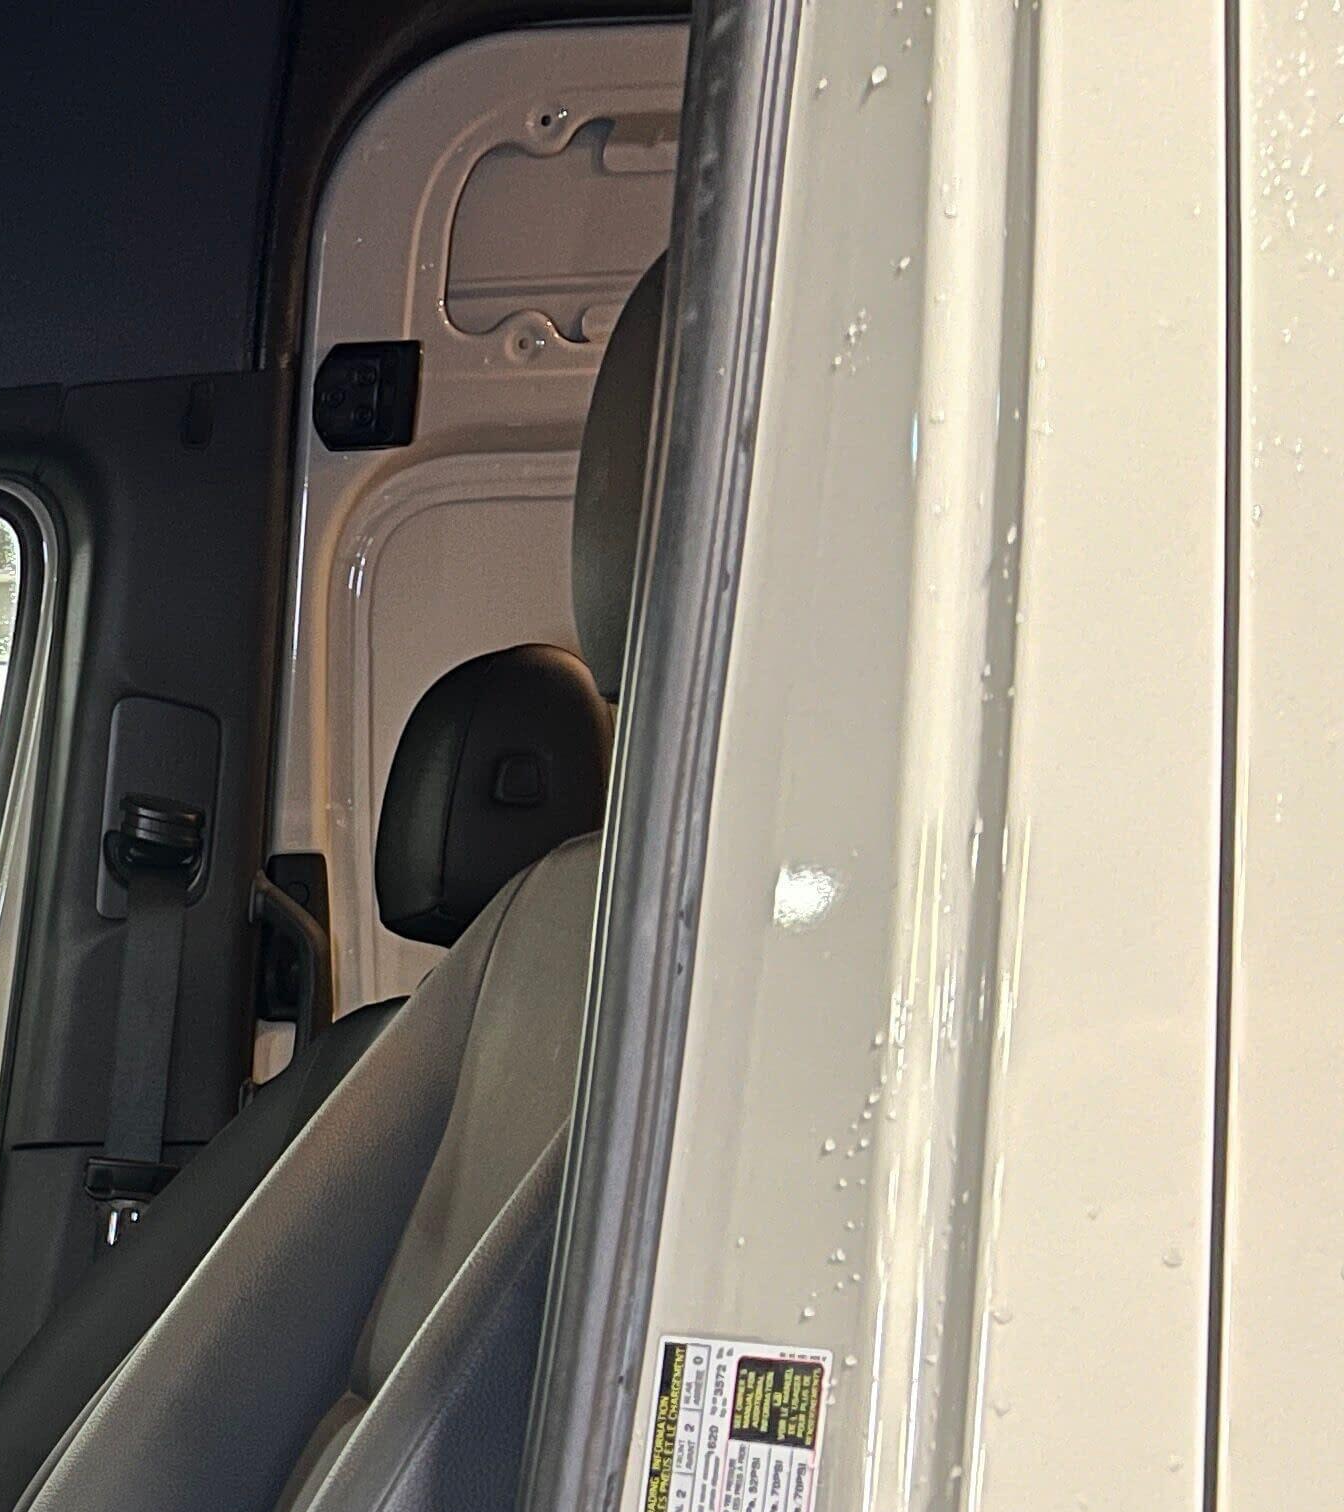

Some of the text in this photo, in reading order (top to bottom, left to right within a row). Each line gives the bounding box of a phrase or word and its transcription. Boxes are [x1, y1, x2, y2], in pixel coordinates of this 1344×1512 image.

[691, 1355, 703, 1365] 0
[667, 1346, 685, 1418] CHARGEMENT
[713, 1363, 726, 1396] 3572
[651, 1395, 669, 1470] INFORMATION
[665, 1425, 675, 1437] LE
[683, 1422, 695, 1432] 2
[663, 1441, 673, 1454] ET
[658, 1455, 671, 1493] PNEUS
[770, 1459, 784, 1497] 70PSI
[793, 1461, 806, 1500] 70PSI
[675, 1488, 686, 1499] 2
